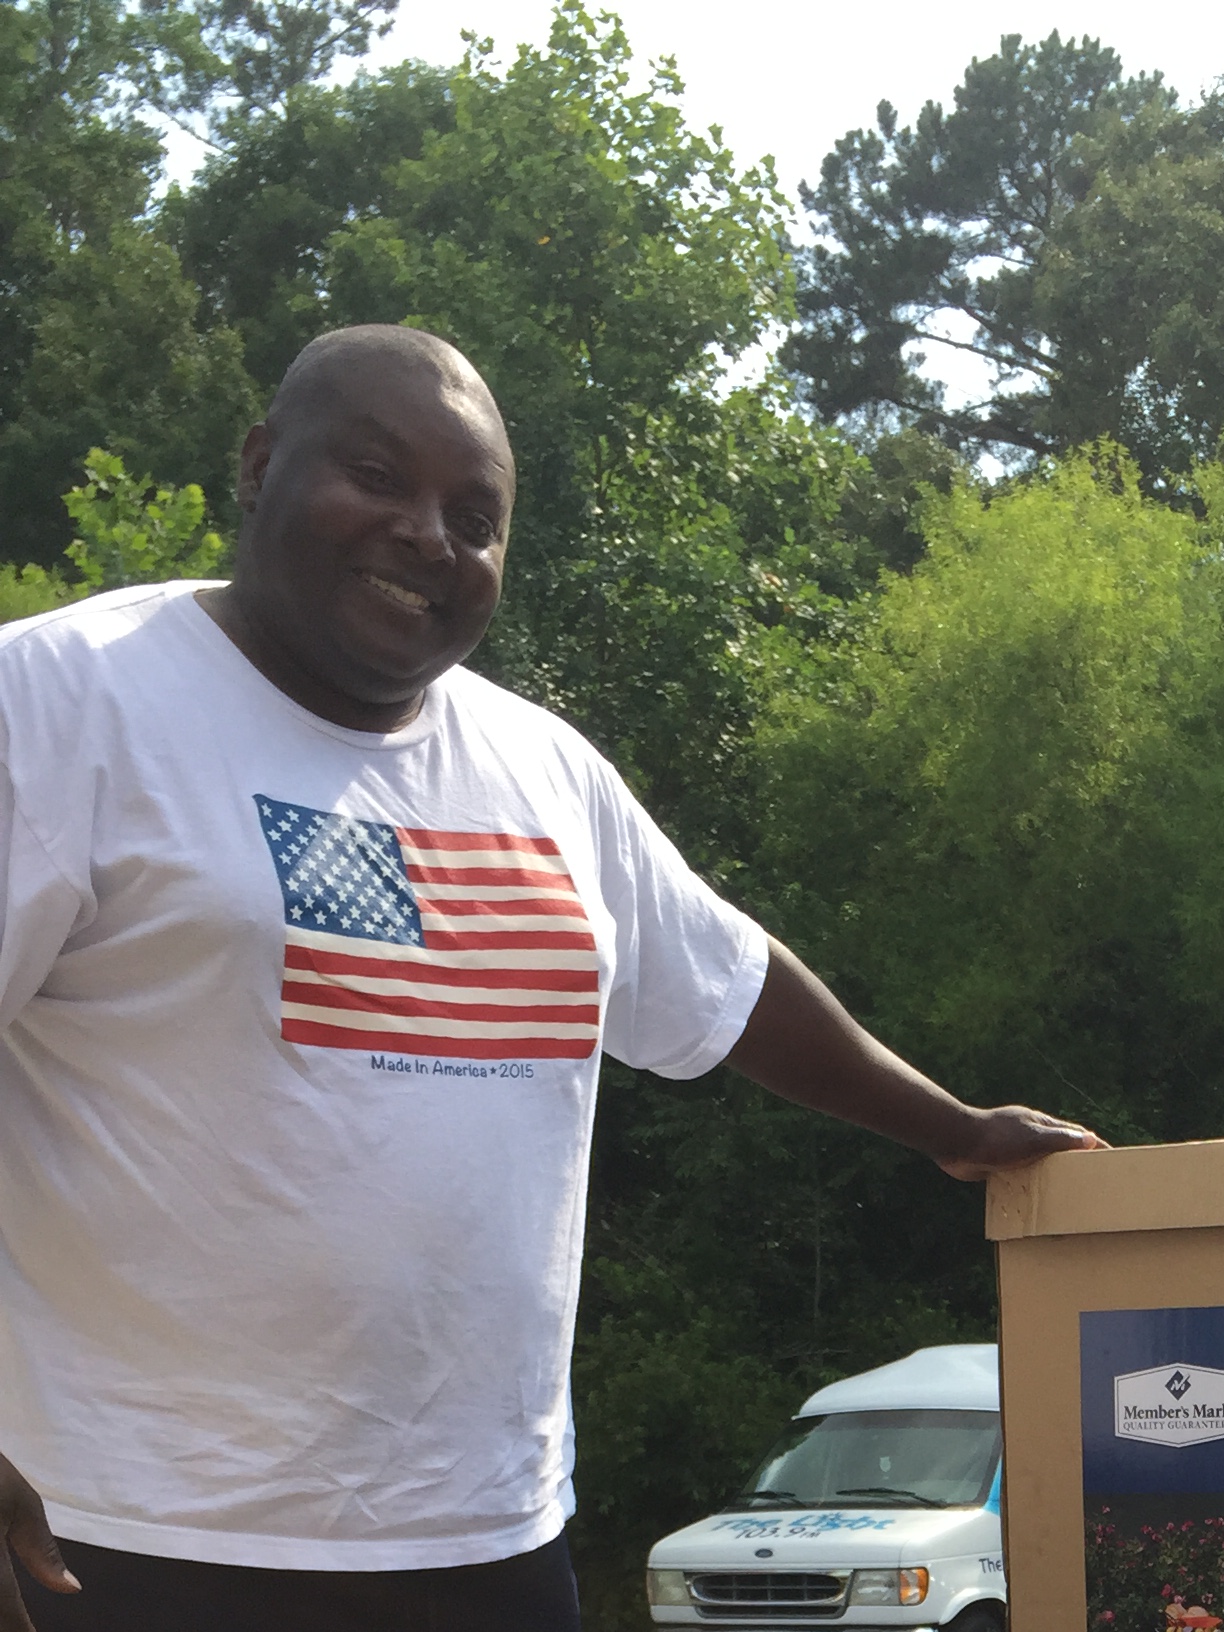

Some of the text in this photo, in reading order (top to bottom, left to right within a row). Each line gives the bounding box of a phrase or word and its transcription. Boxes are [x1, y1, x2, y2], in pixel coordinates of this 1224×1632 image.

[371, 1055, 534, 1078] Made In America 2015
[1123, 1404, 1189, 1420] Member's
[1123, 1421, 1165, 1432] QUALITY
